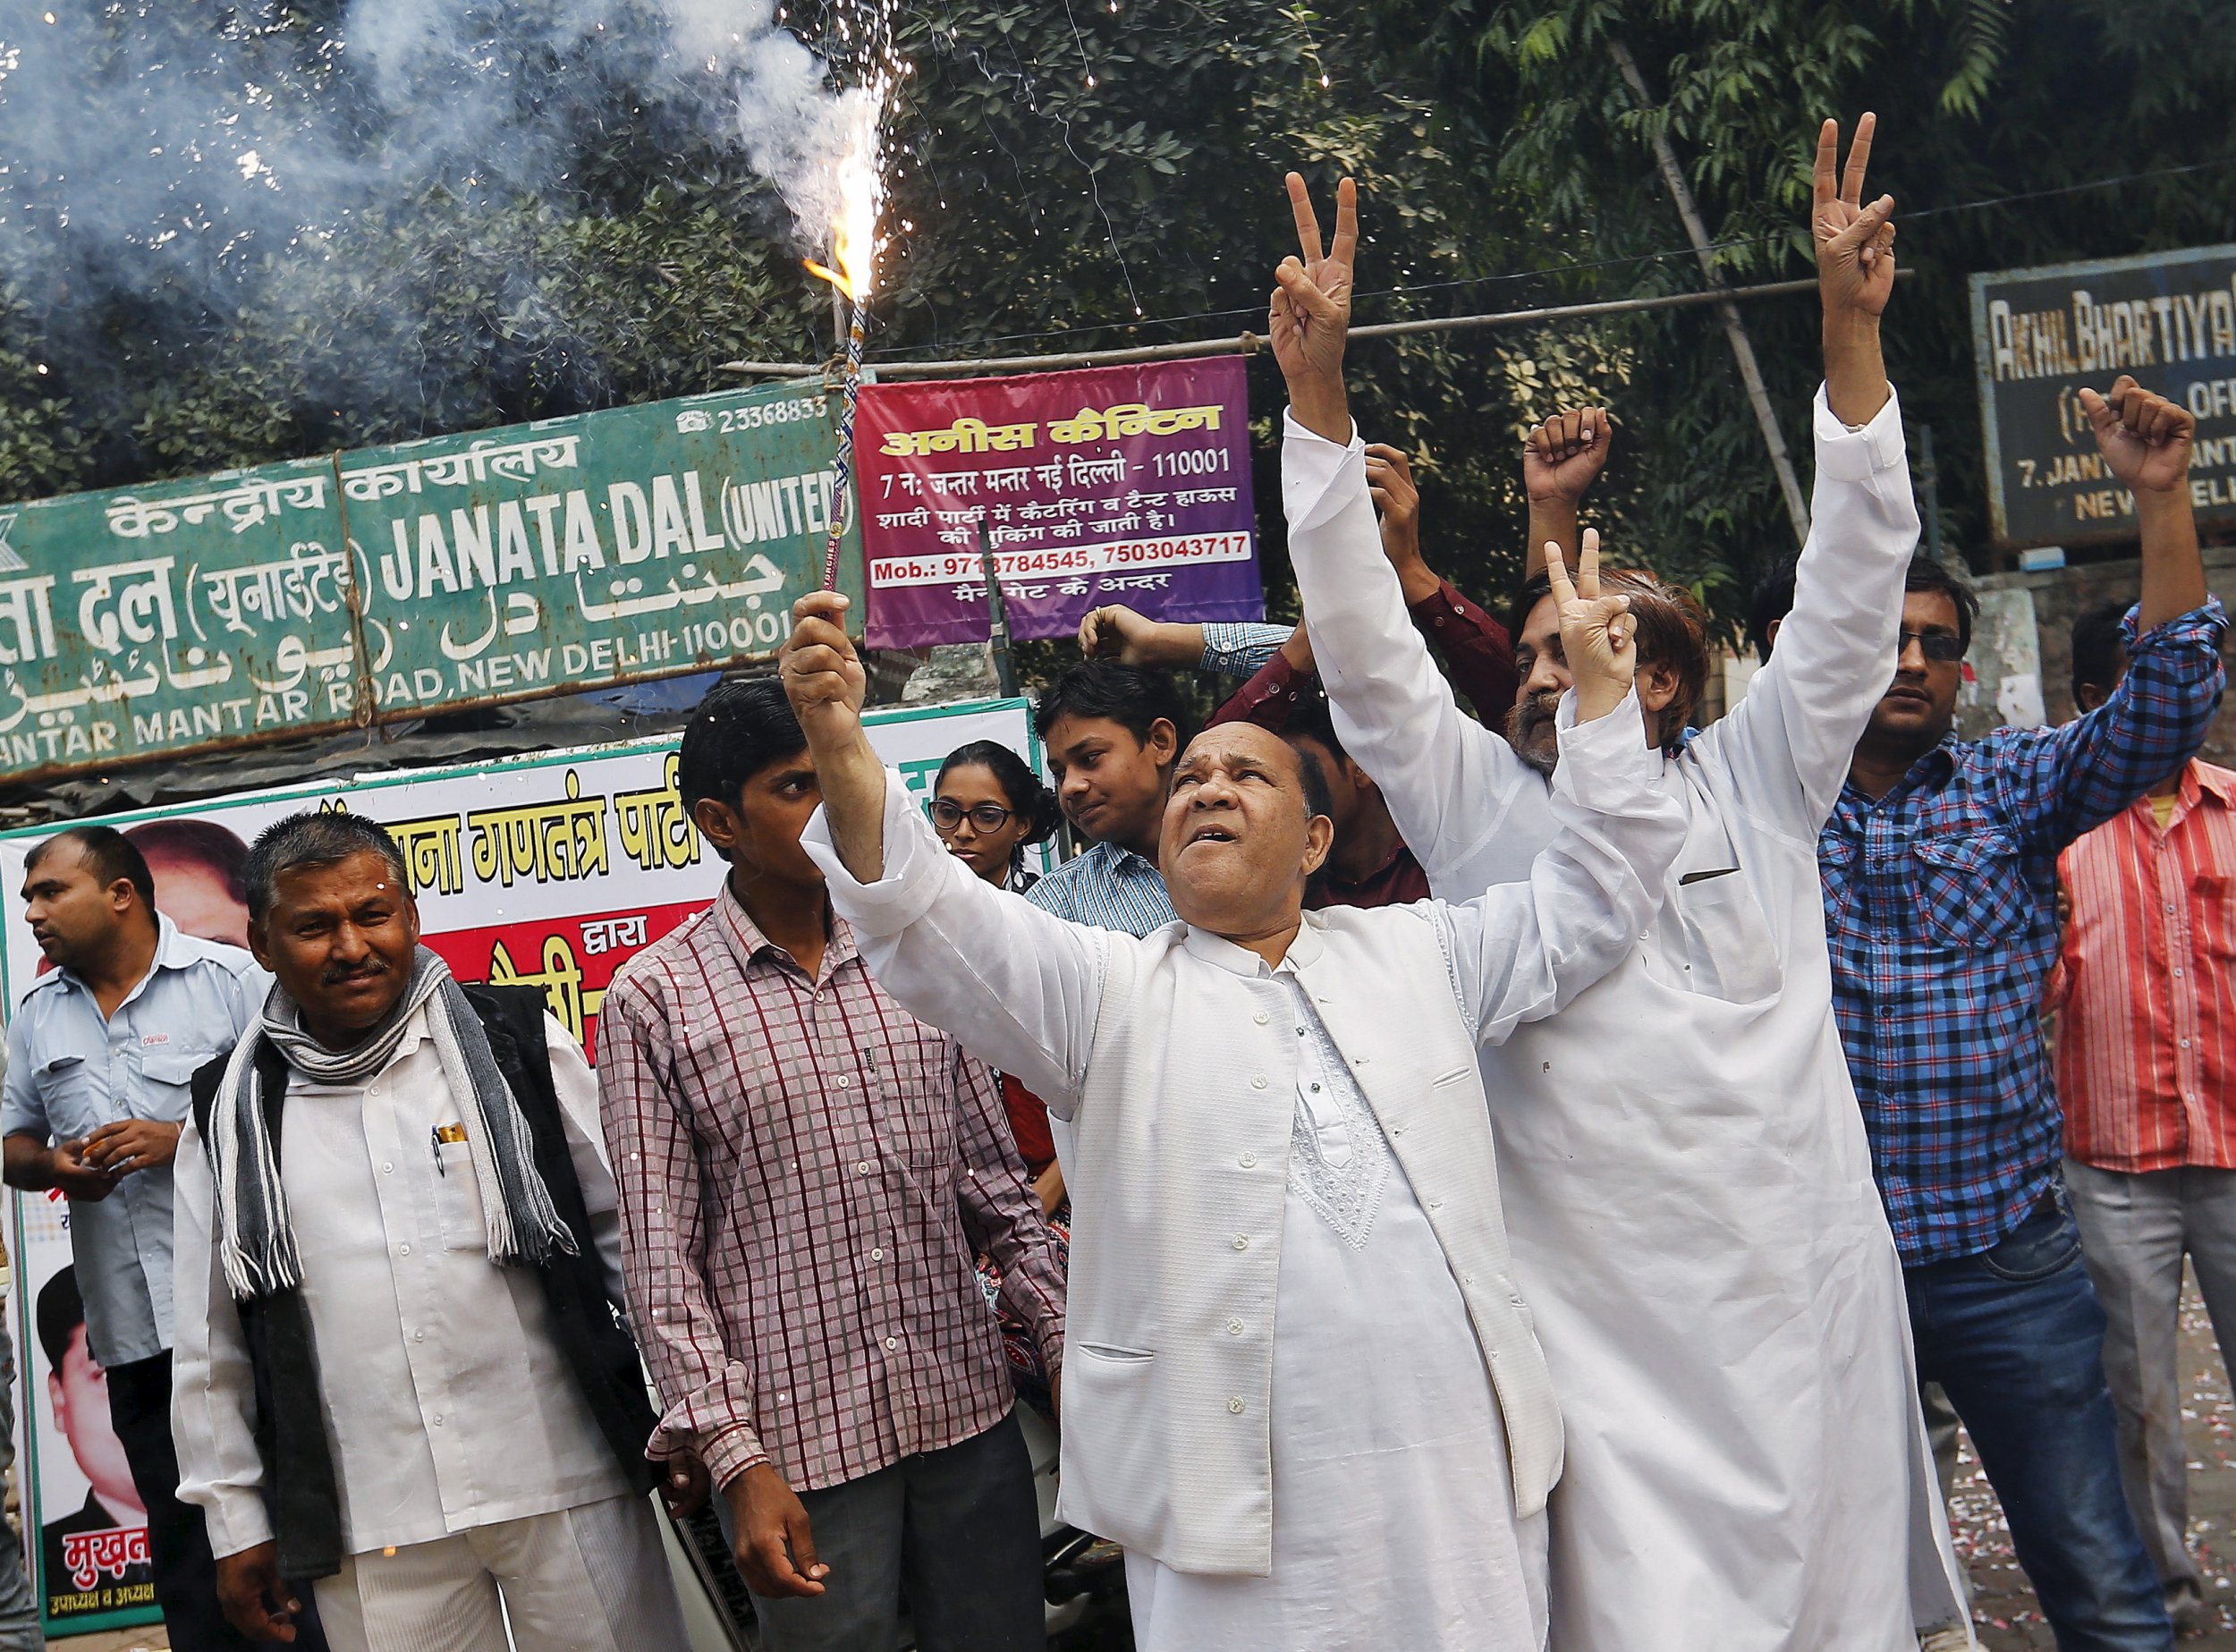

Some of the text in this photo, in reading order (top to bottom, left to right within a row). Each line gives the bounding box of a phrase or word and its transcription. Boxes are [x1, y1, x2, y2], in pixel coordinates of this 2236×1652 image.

[1988, 300, 2079, 382] AKHIL
[2071, 289, 2236, 373] BHARTIYA
[718, 395, 828, 435] 23368833
[879, 418, 1038, 458] अनीस
[880, 474, 894, 499] 7
[928, 470, 979, 496] जन्तर
[983, 464, 1031, 494] मन्तर
[1033, 453, 1063, 495] नई
[1067, 449, 1127, 490] दिल्ली
[1152, 447, 1230, 479] 110001
[104, 475, 328, 538] केन्द्रीय
[379, 459, 854, 602] JANATA DAL (UNITED)
[876, 487, 1238, 529] शादी पार्टी में कैटरिंग व टैन्ट हाऊस
[936, 526, 972, 545] की
[1050, 519, 1083, 538] की
[1088, 512, 1142, 535] जाती
[873, 561, 937, 581] Mob.:
[1103, 536, 1247, 565] 7503043717
[71, 555, 178, 657] दल
[1003, 580, 1052, 600] गेट
[1056, 575, 1089, 597] के
[1097, 572, 1173, 594] अन्दर
[132, 689, 309, 747] MANTAR
[459, 647, 553, 694] NEW
[467, 768, 610, 888] गणतंत्र
[580, 915, 648, 955] द्वारा
